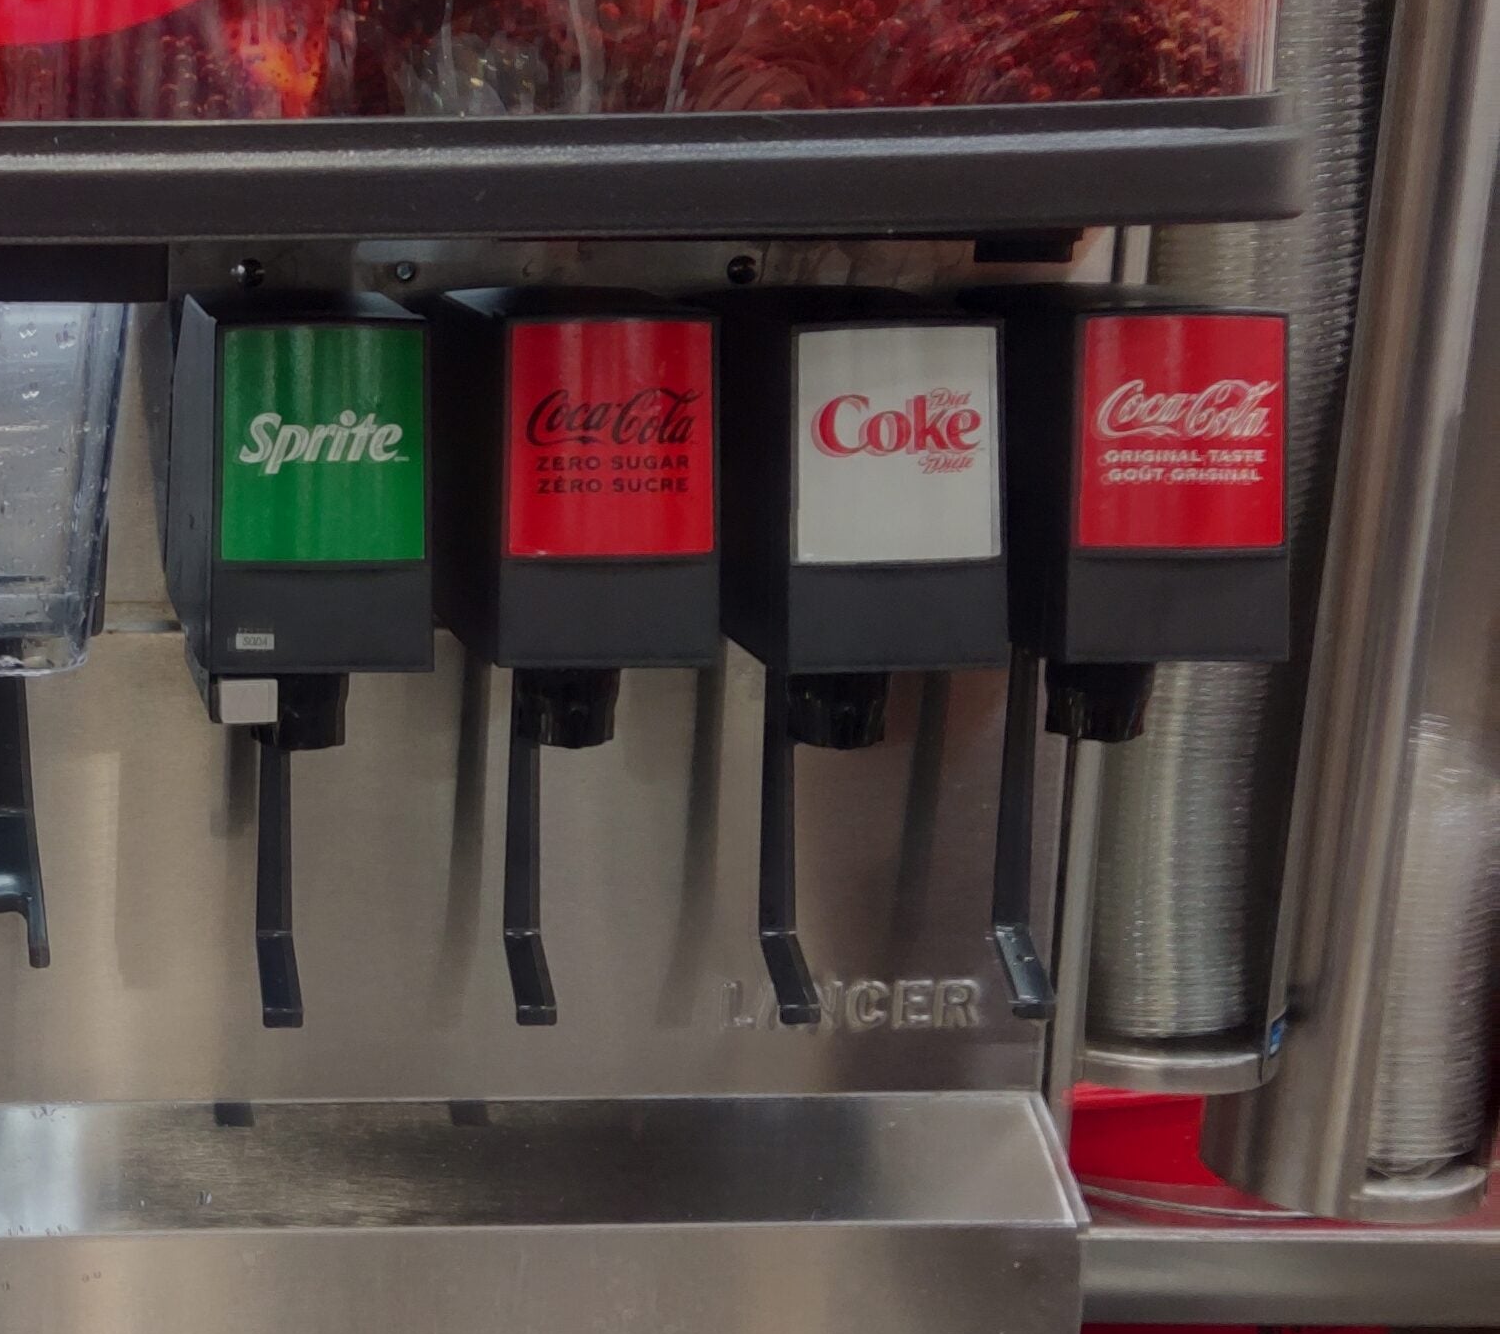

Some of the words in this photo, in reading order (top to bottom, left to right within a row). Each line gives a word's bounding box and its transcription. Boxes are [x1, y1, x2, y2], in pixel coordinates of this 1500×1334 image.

[526, 387, 702, 447] Coca-Cola
[812, 394, 982, 457] Coke
[1096, 378, 1280, 439] Coca-Cola
[239, 409, 404, 475] Sprite
[1103, 449, 1202, 463] ORIGINAL
[1207, 449, 1267, 463] TASTE
[536, 455, 601, 471] ZERO
[611, 455, 690, 471] SUGAR
[1170, 467, 1264, 482] ORIGINAL
[537, 475, 602, 494] ZÉRO
[612, 478, 689, 493] SUCRE
